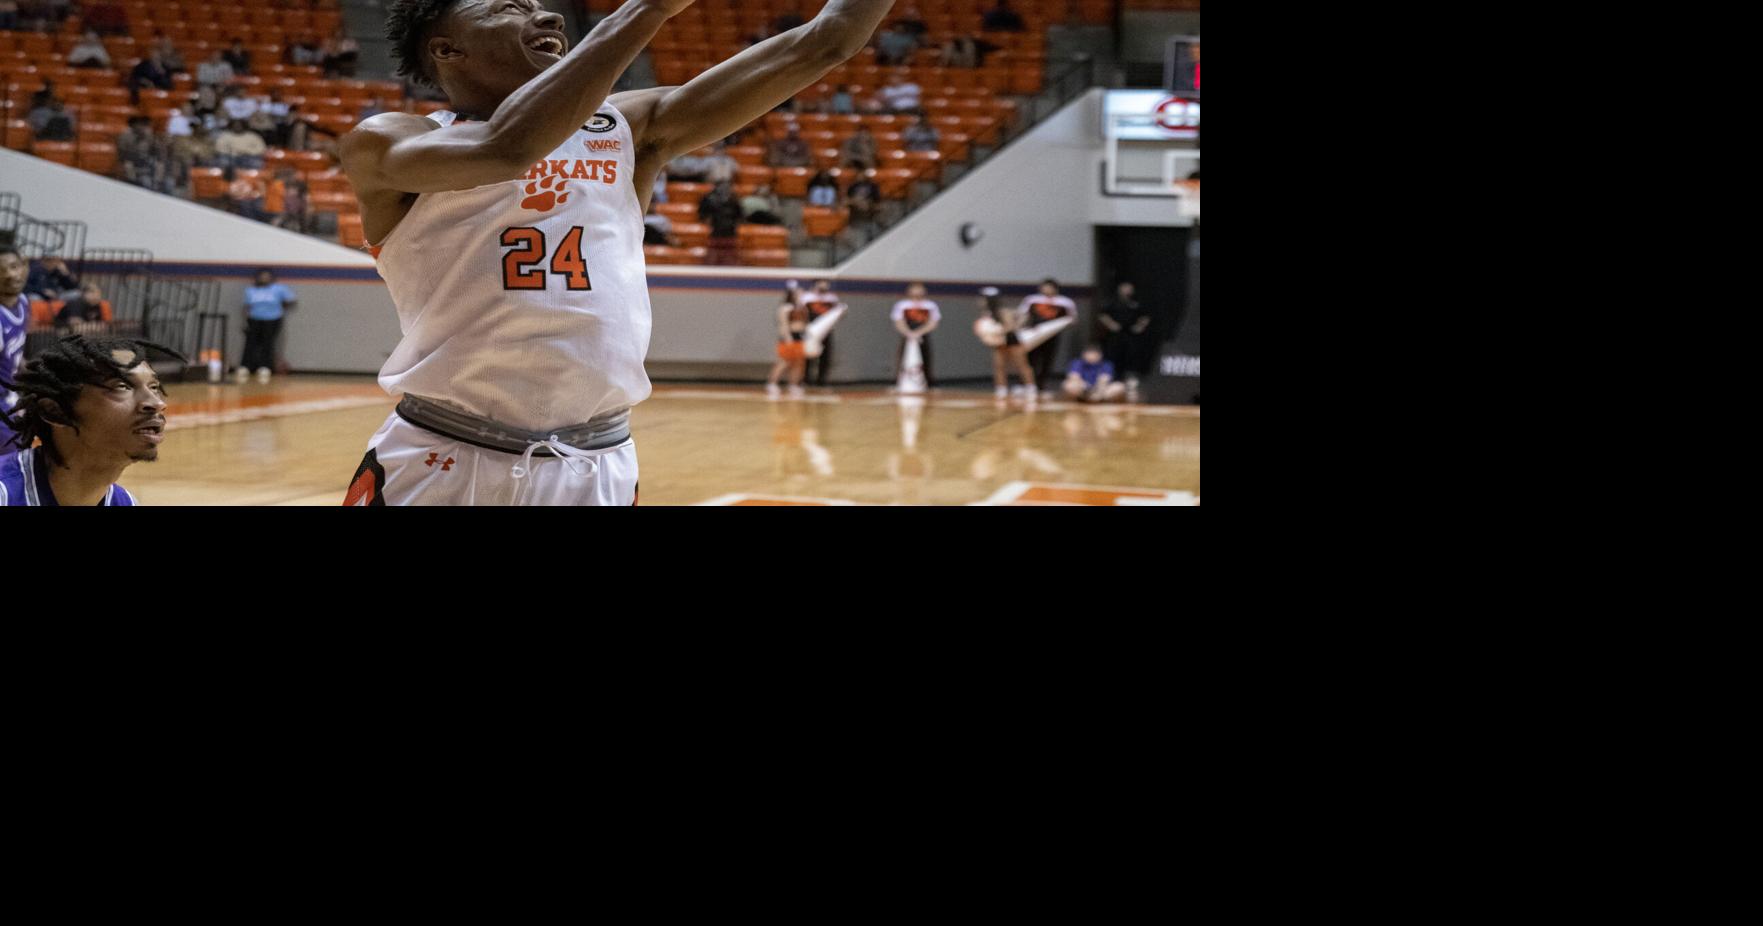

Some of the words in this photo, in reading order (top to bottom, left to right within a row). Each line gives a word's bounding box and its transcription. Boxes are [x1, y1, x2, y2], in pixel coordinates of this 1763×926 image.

[584, 139, 621, 152] WAC
[518, 159, 617, 184] RKATS
[500, 226, 592, 291] 24
